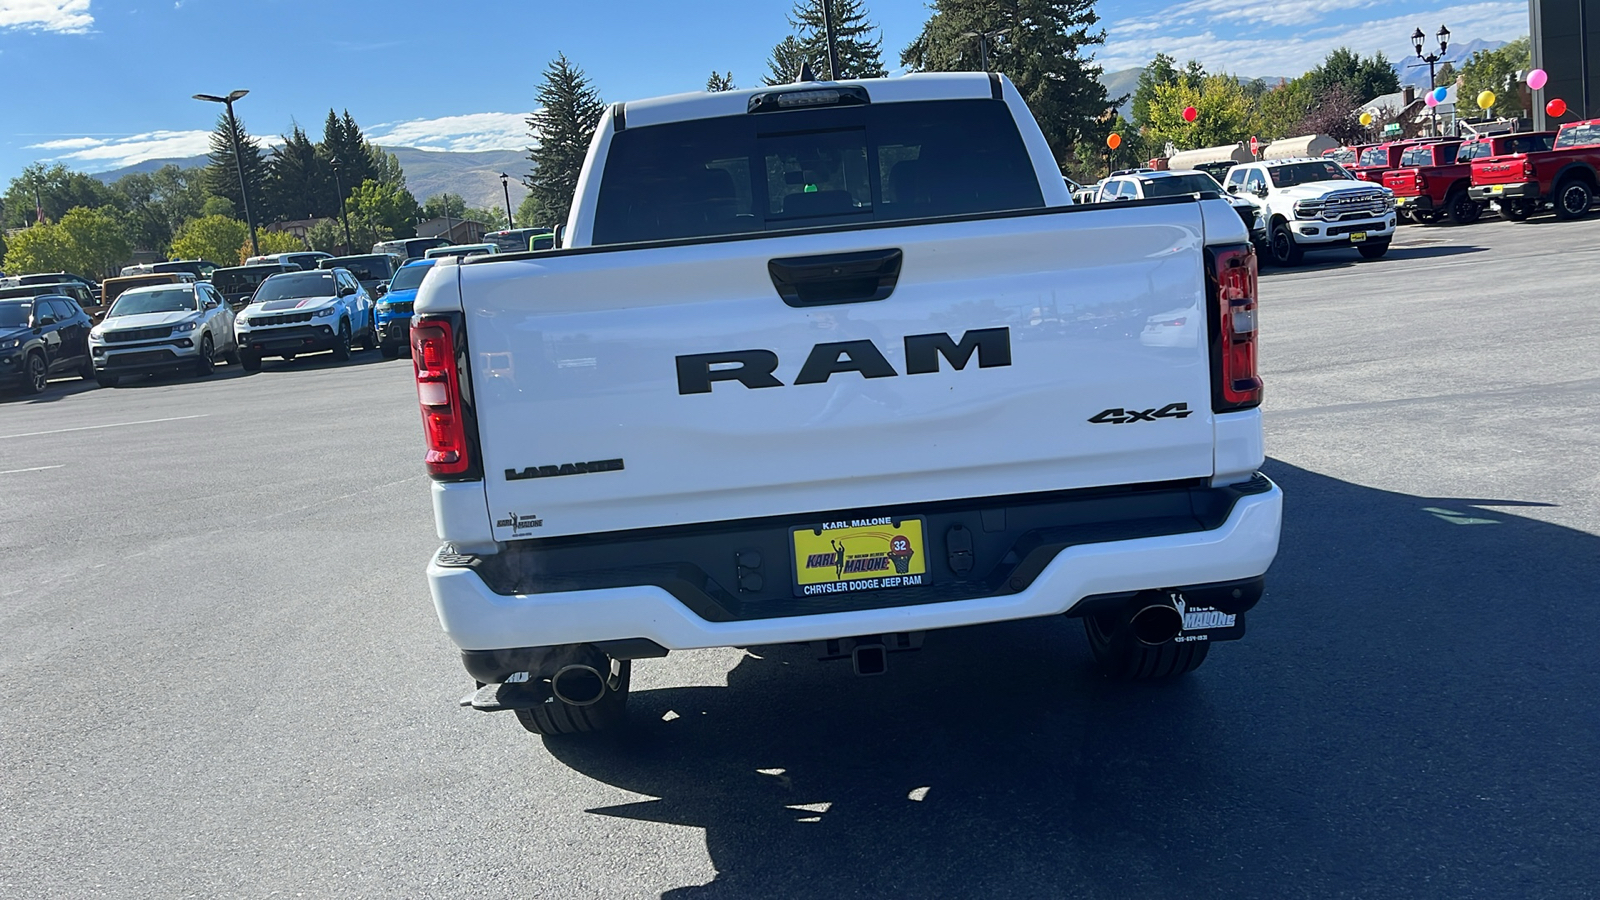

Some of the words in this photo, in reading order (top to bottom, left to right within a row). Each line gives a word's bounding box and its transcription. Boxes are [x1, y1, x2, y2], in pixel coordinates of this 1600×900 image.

[1482, 164, 1510, 172] RAM
[675, 326, 1012, 395] RAM
[1087, 402, 1194, 424] 4x4
[822, 520, 849, 530] KARL
[851, 516, 892, 528] MALONE
[893, 540, 907, 551] 32
[805, 552, 837, 569] KARL
[843, 557, 890, 574] MALONE
[803, 581, 848, 595] CHRYSLER
[849, 578, 879, 591] DODGE
[880, 576, 902, 588] JEEP
[902, 575, 922, 586] RAM
[1182, 611, 1237, 630] MALONE
